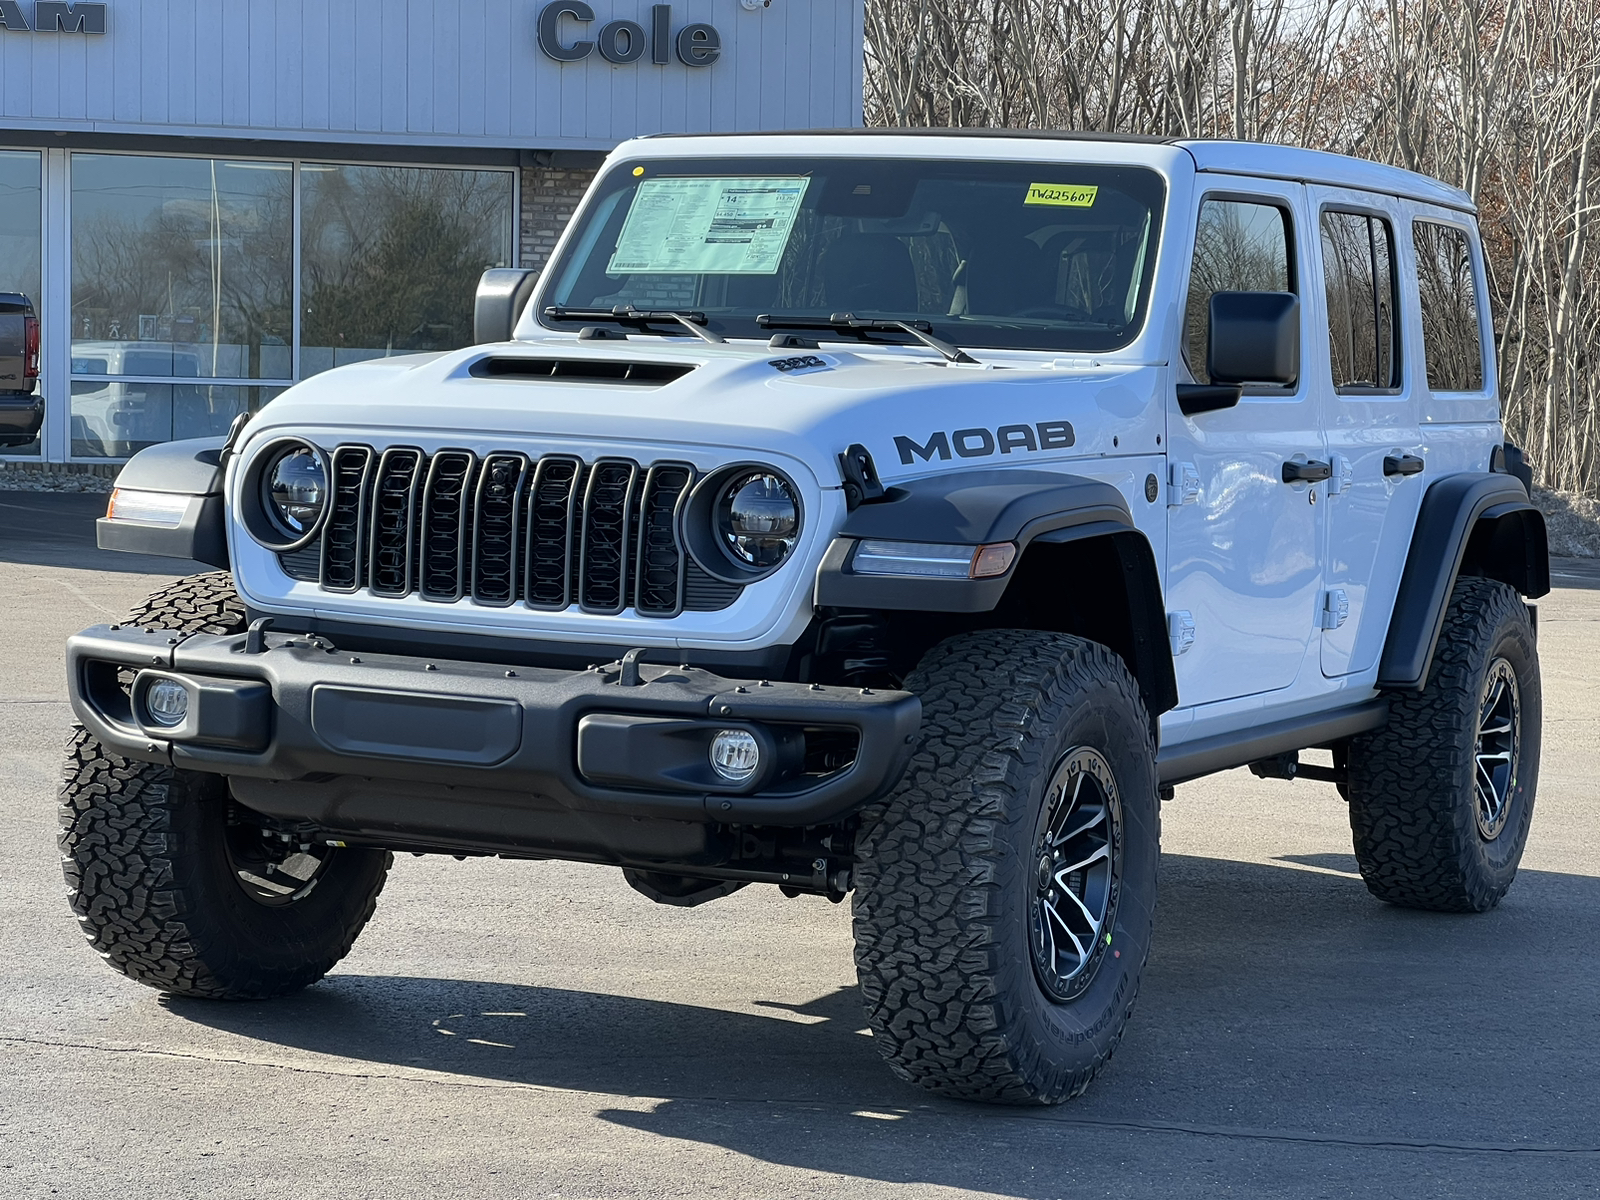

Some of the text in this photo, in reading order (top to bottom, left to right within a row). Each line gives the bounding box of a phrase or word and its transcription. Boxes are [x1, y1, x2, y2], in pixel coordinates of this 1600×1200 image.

[537, 0, 721, 67] Cole
[1030, 188, 1095, 204] TW225607
[893, 420, 1076, 465] MOAB
